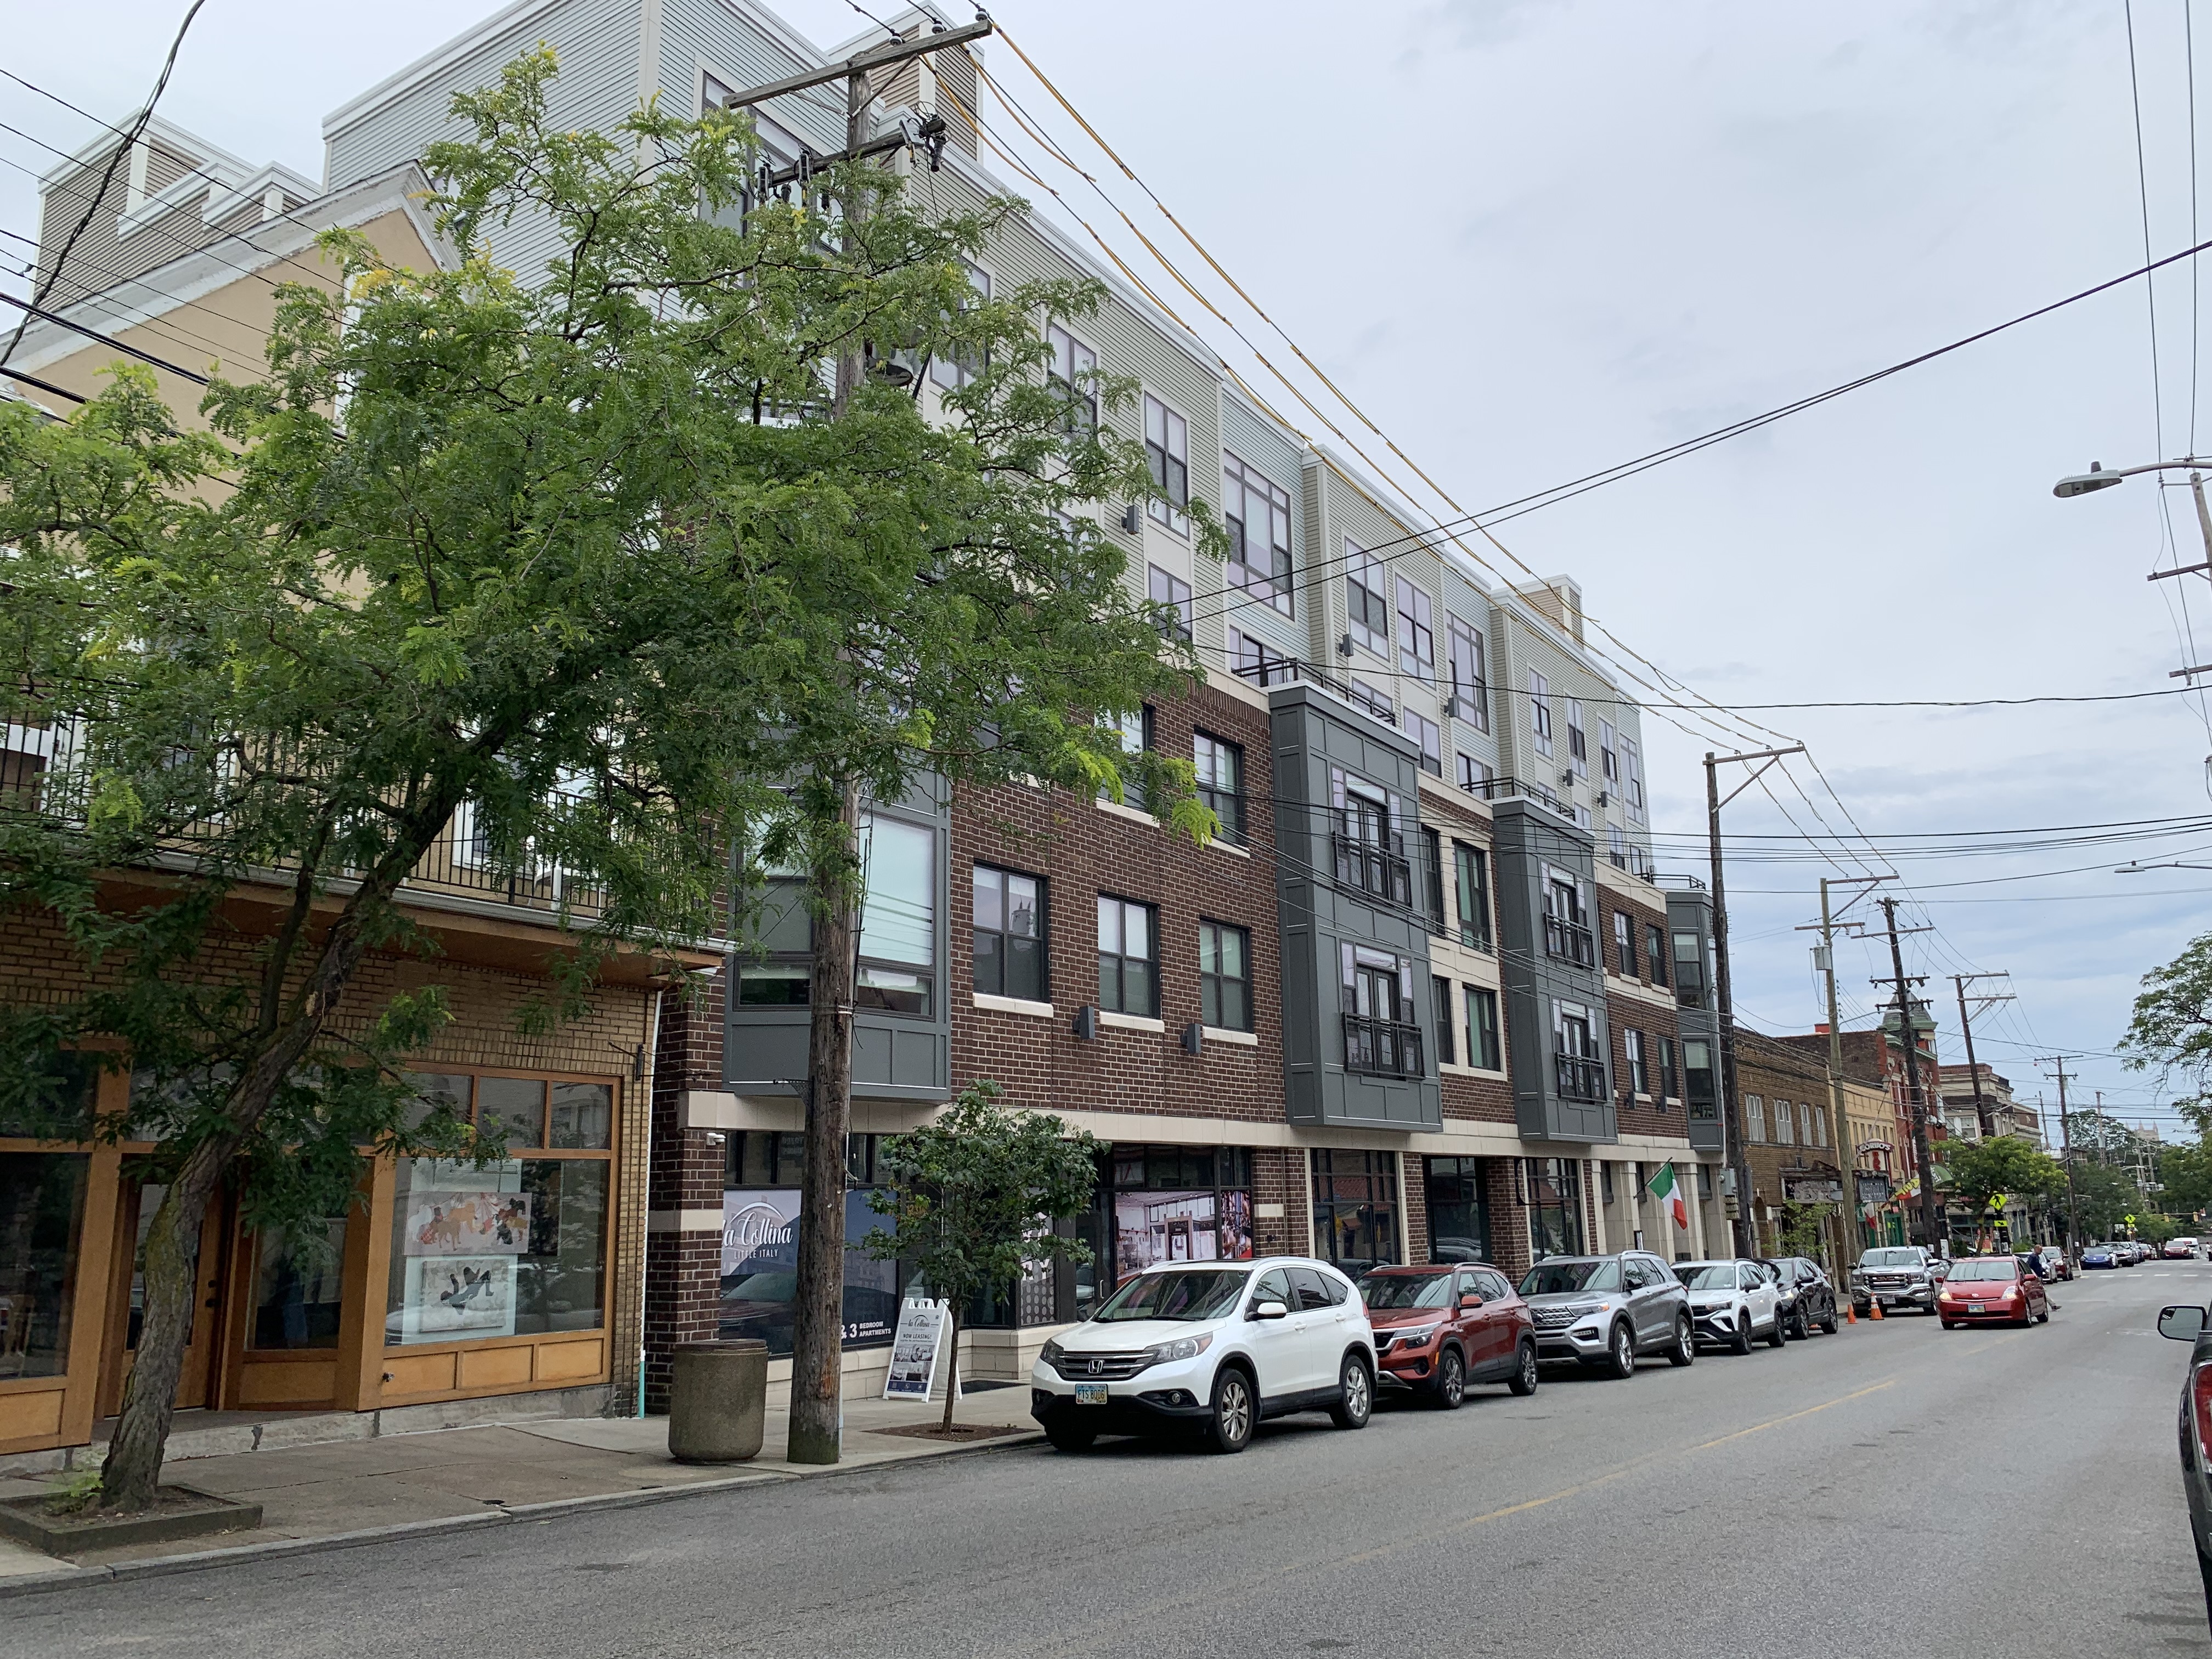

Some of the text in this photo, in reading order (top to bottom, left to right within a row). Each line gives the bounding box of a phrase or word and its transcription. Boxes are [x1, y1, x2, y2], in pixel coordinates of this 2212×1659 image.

[737, 1211, 793, 1245] Collina
[734, 1249, 778, 1259] LITTLE ITALY
[849, 1323, 857, 1338] 3
[859, 1328, 891, 1337] APARTMENTS
[1078, 1389, 1089, 1399] FTS
